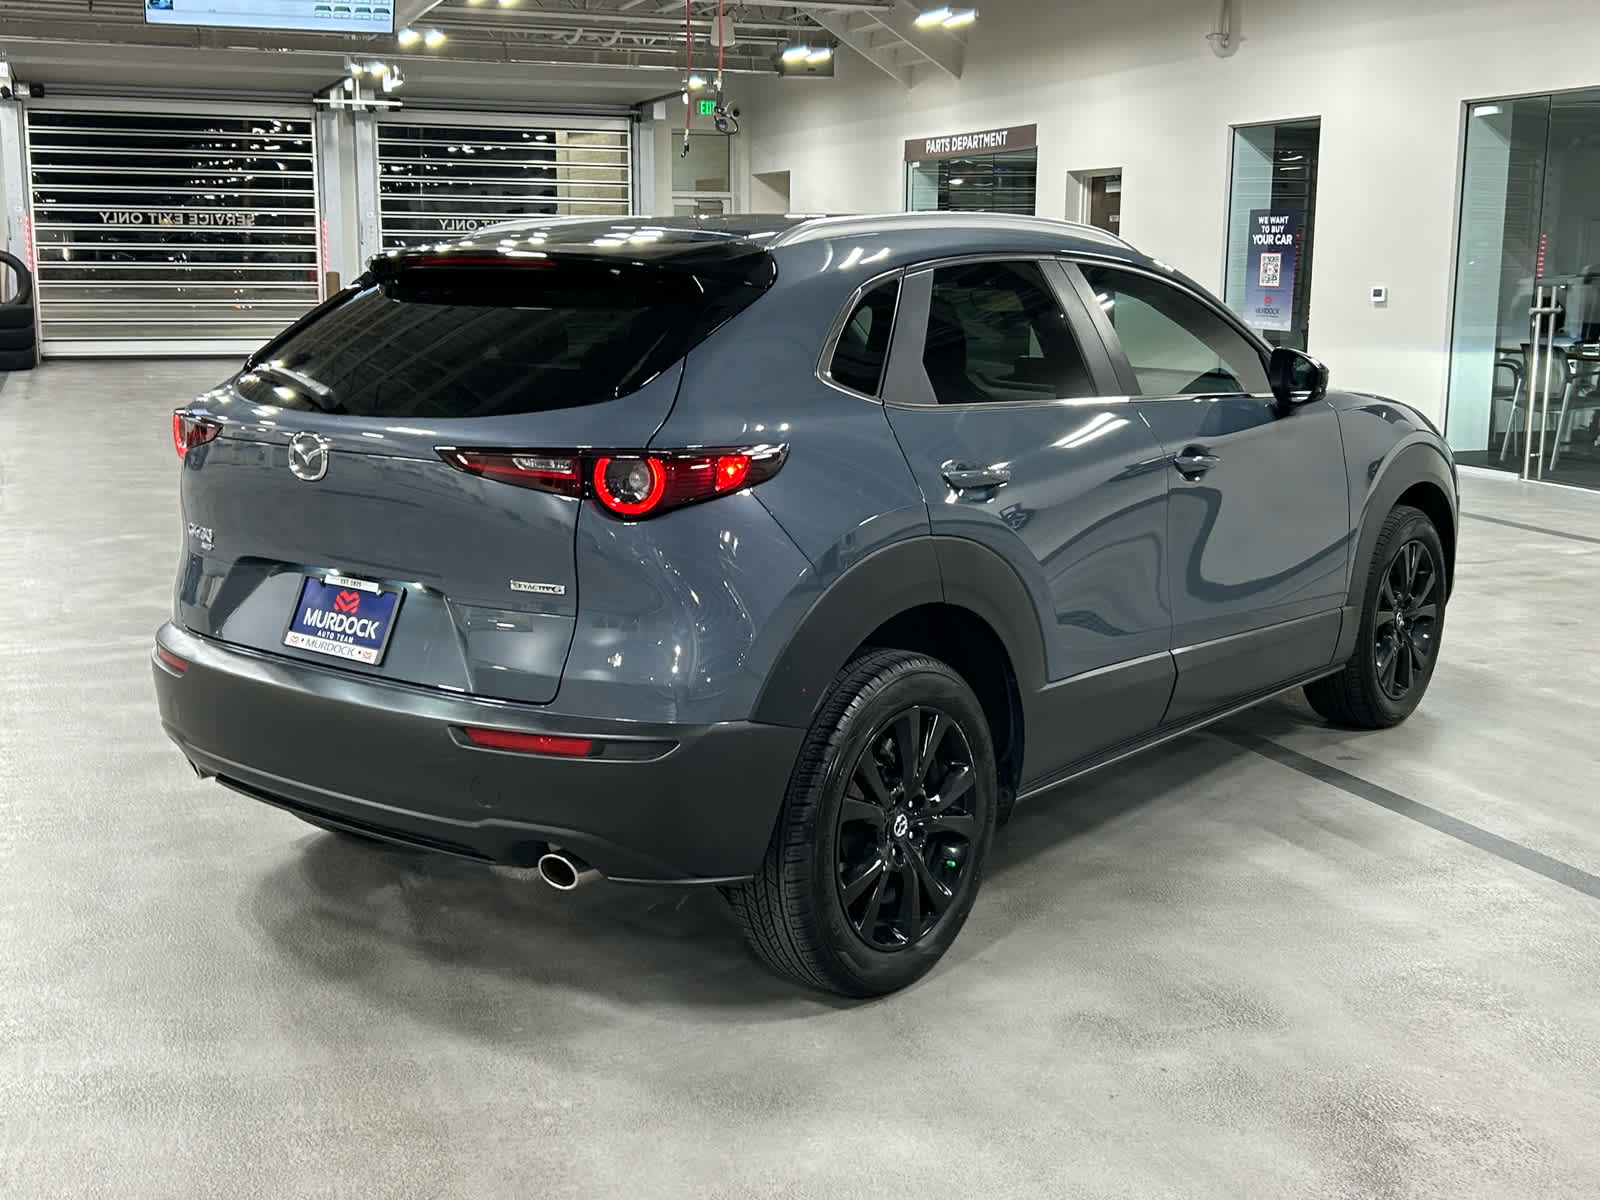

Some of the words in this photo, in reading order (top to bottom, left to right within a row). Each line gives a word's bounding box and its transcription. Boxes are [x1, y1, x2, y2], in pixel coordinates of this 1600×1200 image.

[925, 139, 950, 154] PARTS
[951, 131, 1008, 151] DEPARTMENT
[1258, 216, 1269, 225] WE
[1269, 215, 1289, 225] WANT
[1261, 226, 1270, 234] TO
[1271, 225, 1285, 234] BUY
[1252, 234, 1274, 245] YOUR
[1275, 234, 1293, 245] CAR
[303, 607, 380, 640] MURDOCK
[317, 629, 335, 640] AUTO
[336, 632, 354, 644] TEAM
[305, 638, 355, 657] MURDOCK
